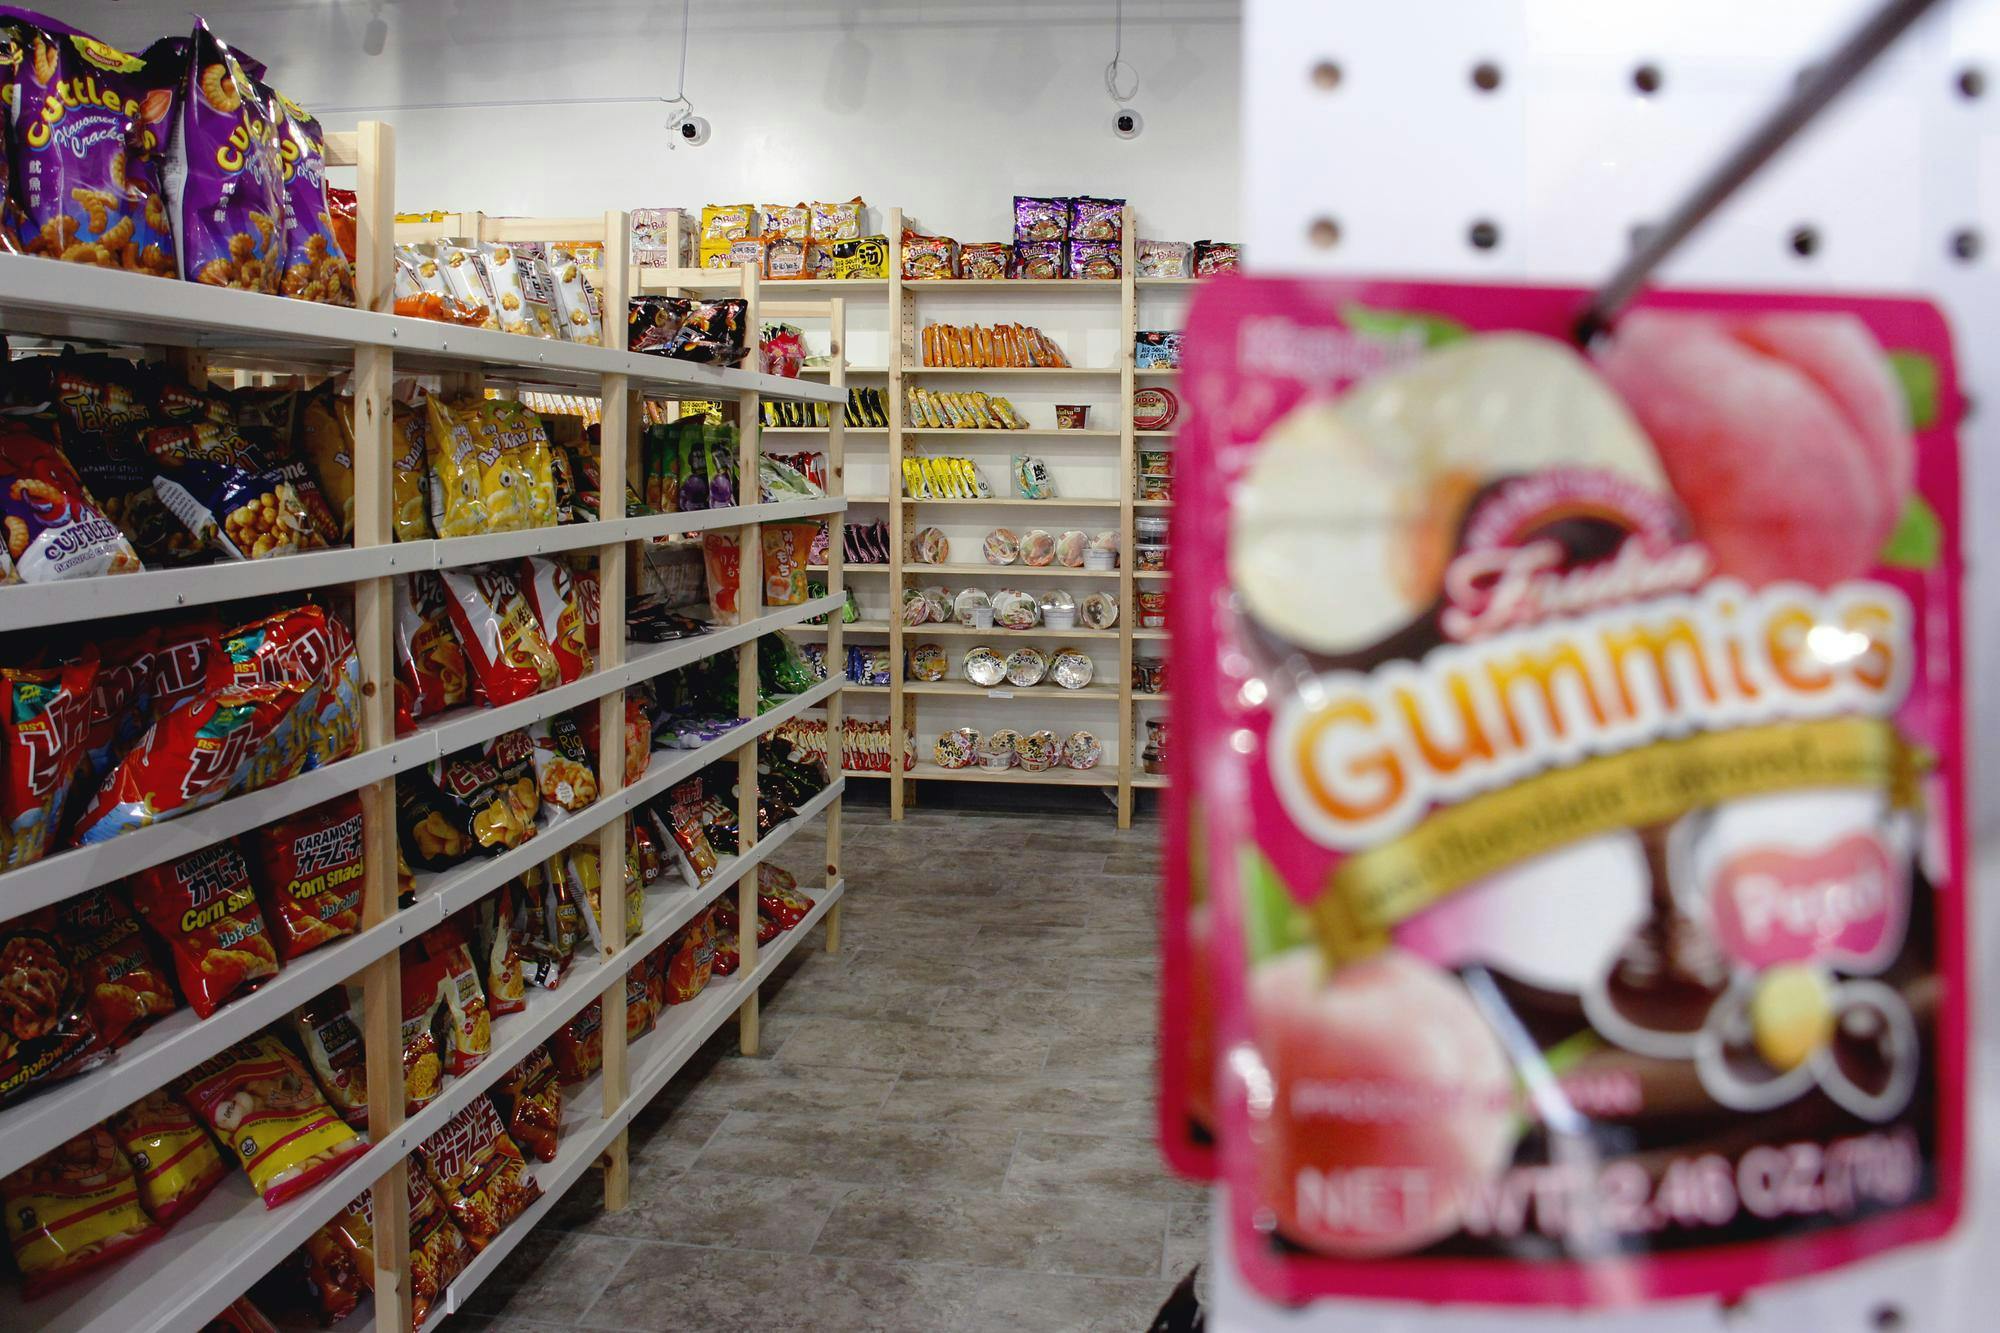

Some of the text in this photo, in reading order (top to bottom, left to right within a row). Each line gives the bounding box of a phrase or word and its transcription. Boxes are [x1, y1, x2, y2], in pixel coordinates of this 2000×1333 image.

[1288, 598, 1902, 832] Gummies
[288, 870, 325, 900] Corn
[180, 899, 226, 933] Corn
